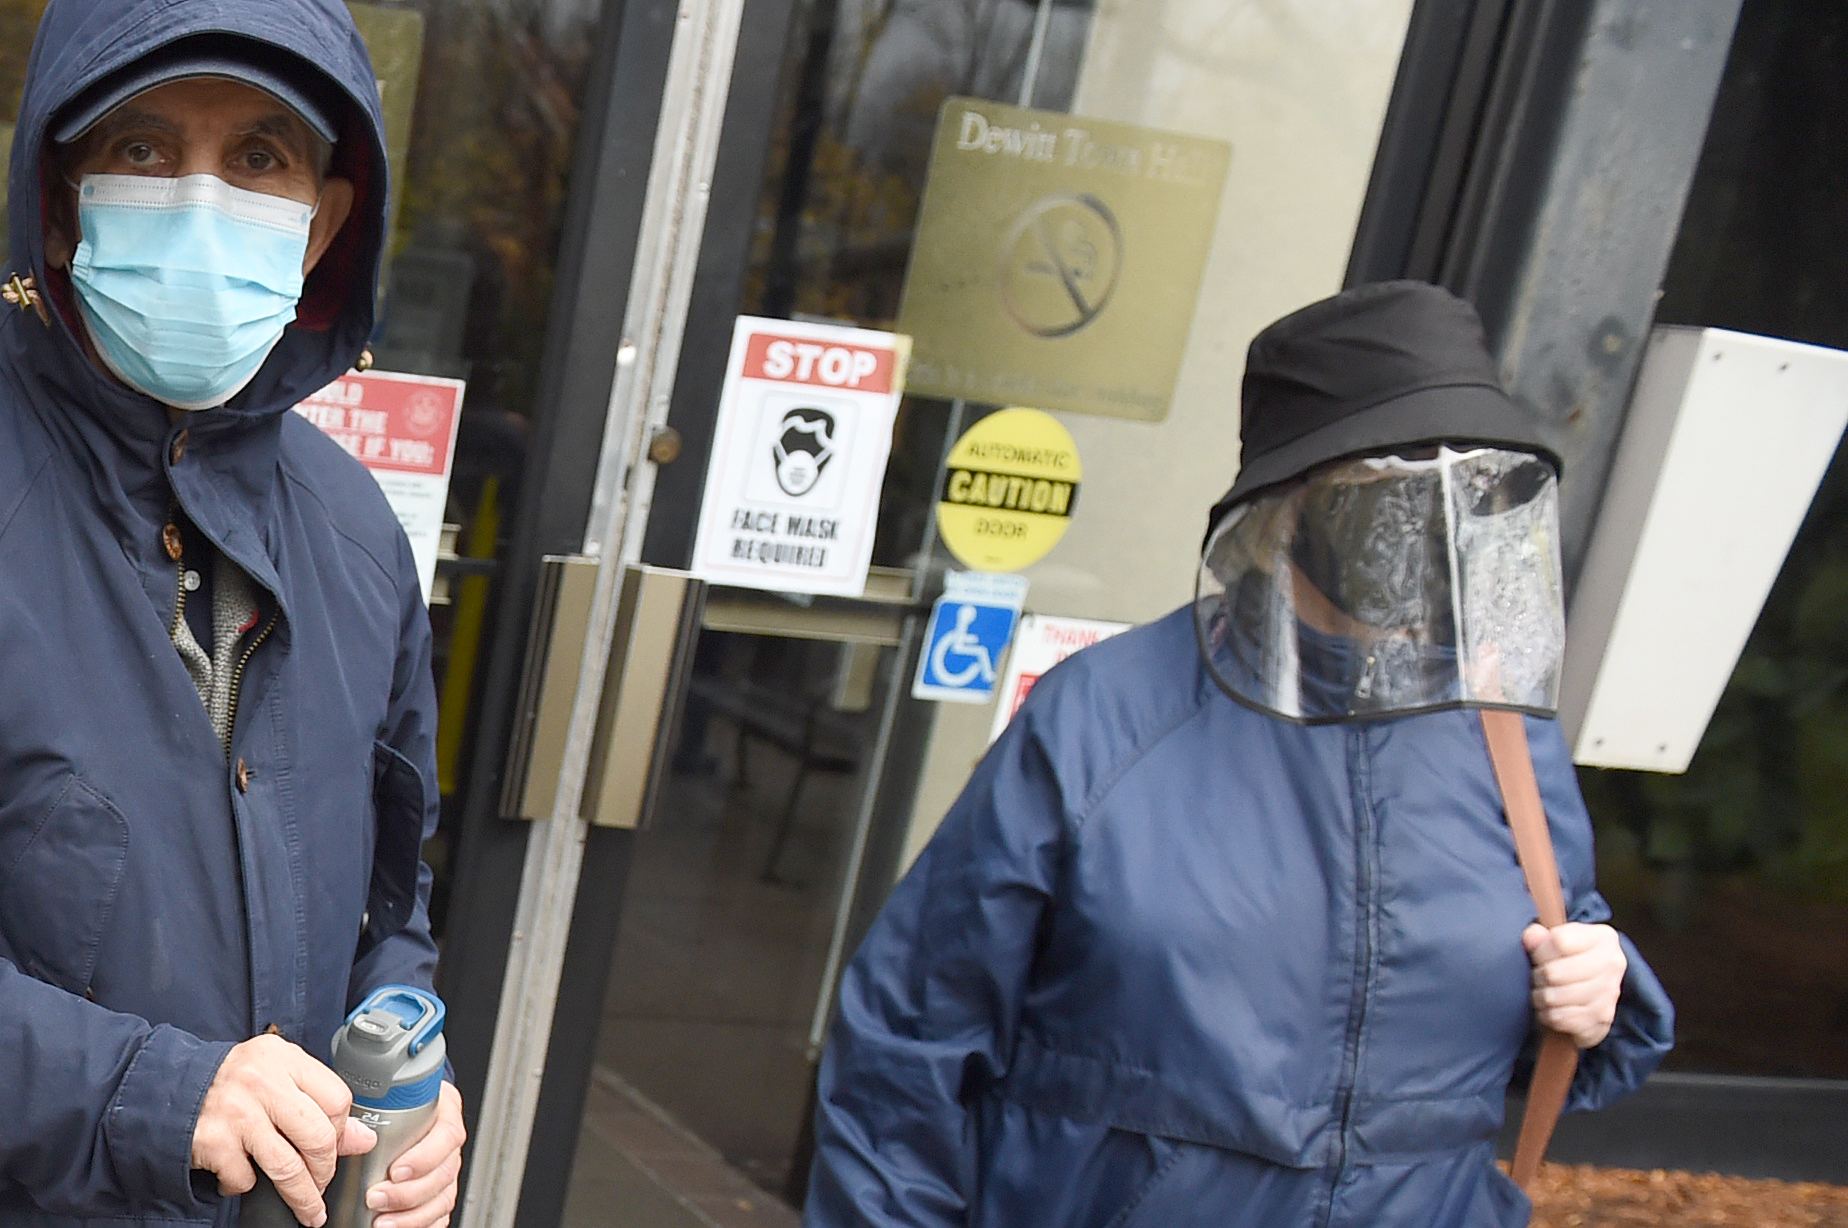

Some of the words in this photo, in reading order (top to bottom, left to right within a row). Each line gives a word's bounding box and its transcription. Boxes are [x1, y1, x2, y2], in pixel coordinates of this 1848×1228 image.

[1063, 128, 1142, 176] Town
[762, 340, 878, 387] STOP
[350, 408, 389, 435] THE
[363, 435, 386, 460] IF
[968, 442, 1072, 468] AUTOMATIC
[949, 469, 1073, 515] CAUTION
[731, 509, 779, 534] FACE
[785, 515, 840, 541] MASK
[974, 517, 1029, 541] DOOR
[731, 538, 826, 568] REQUIRED
[361, 1111, 380, 1122] 24
